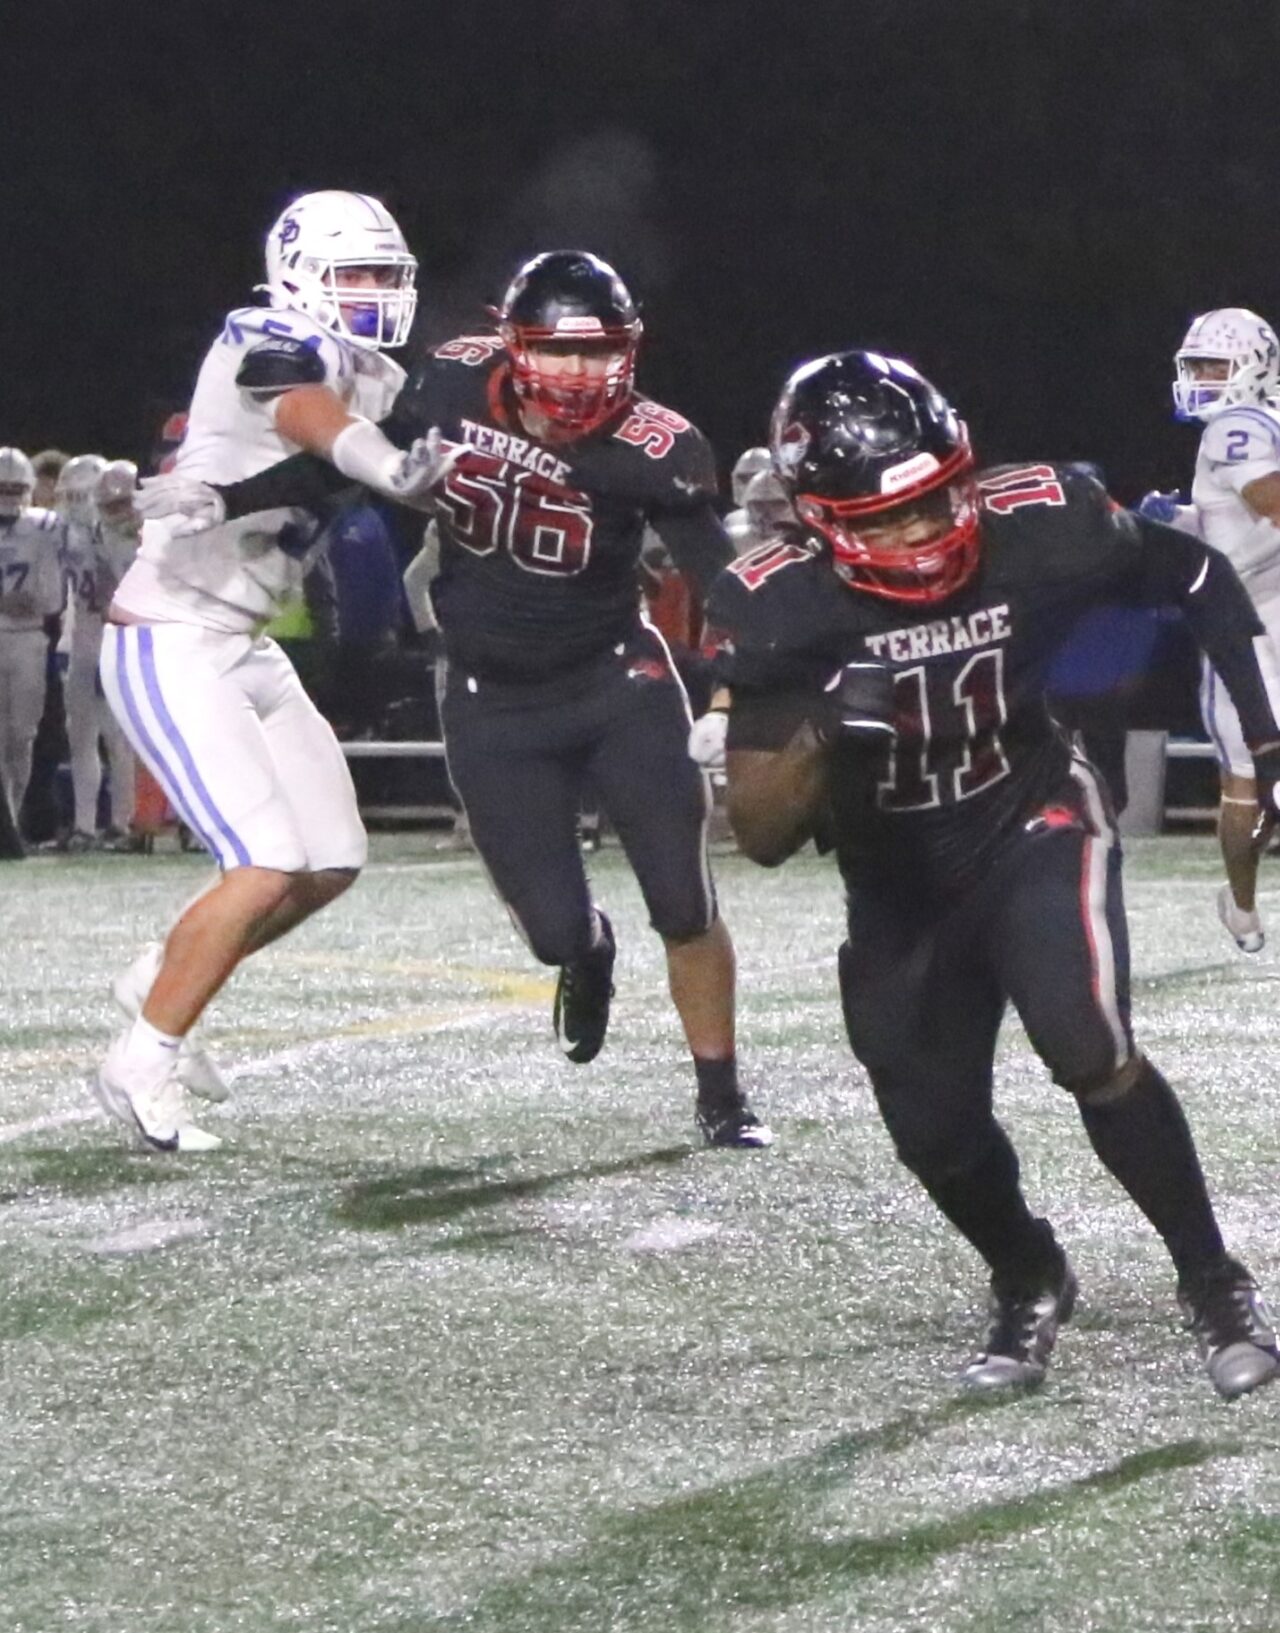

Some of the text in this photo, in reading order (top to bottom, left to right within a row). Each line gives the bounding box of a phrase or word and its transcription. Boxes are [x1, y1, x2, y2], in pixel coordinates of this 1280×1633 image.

[460, 418, 573, 486] TERRACE
[613, 401, 691, 459] 56
[1226, 430, 1250, 461] 2
[433, 438, 594, 577] 56
[977, 465, 1067, 515] 11
[0, 562, 30, 593] 7
[865, 604, 1013, 663] TERRACE
[877, 648, 1012, 813] 11
